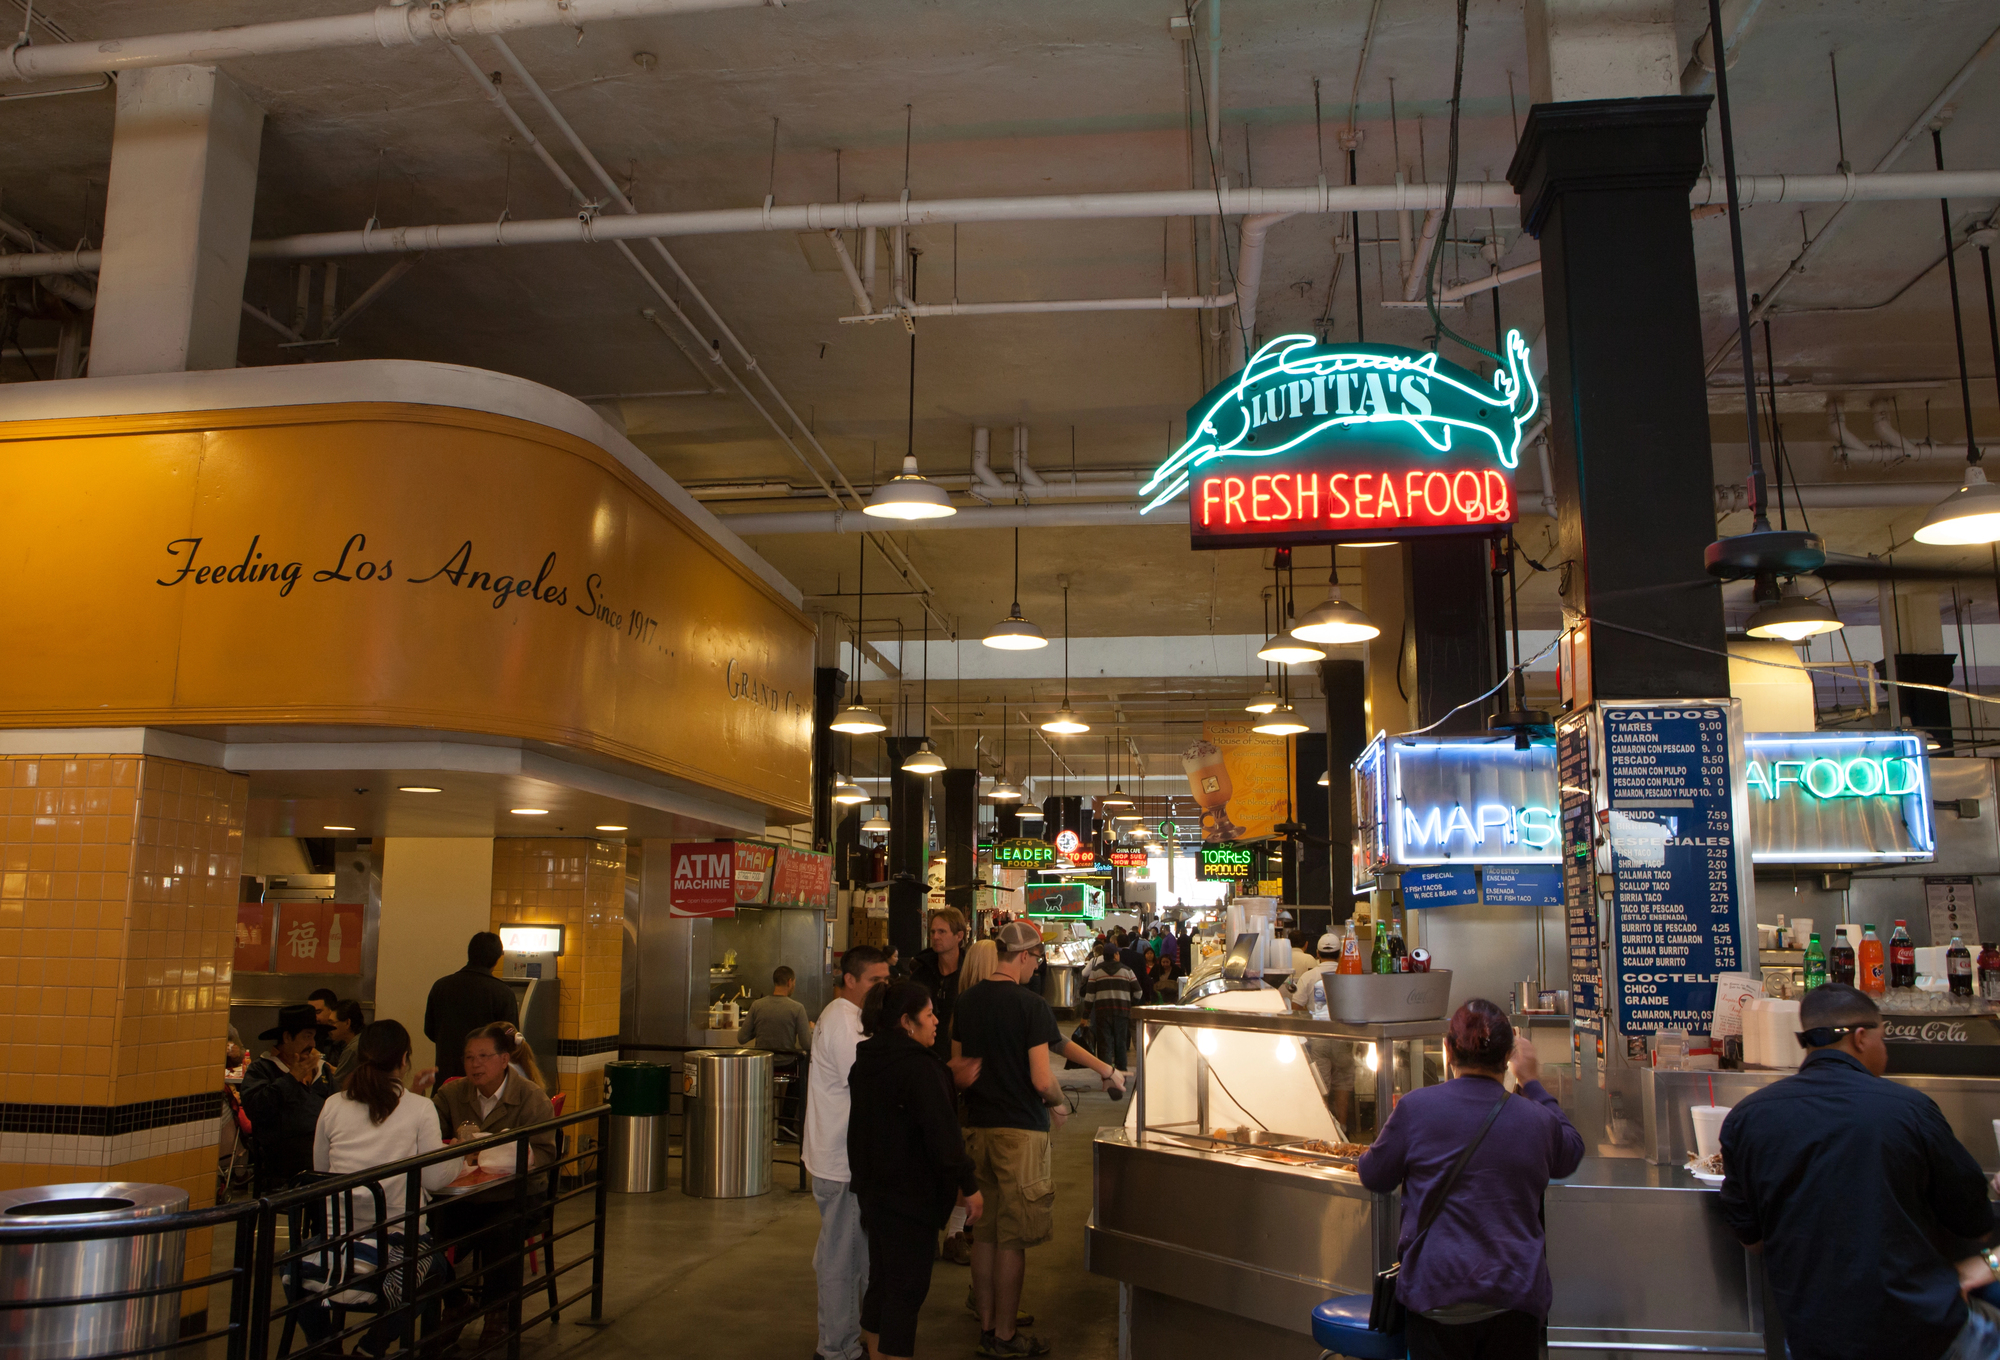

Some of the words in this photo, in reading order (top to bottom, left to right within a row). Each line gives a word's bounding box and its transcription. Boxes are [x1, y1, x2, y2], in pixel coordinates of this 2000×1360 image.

[1251, 373, 1432, 428] LUPITA'S
[1203, 473, 1318, 524] FRESH
[1329, 470, 1508, 519] SEAFOOD
[1466, 499, 1510, 522] D-3
[156, 534, 302, 597] Feeding
[313, 534, 393, 583] Los
[407, 541, 568, 609] Angeles
[575, 573, 622, 631] Since
[727, 658, 778, 713] GRAND
[1609, 710, 1720, 720] CALDOS
[1619, 723, 1652, 732] MARES
[1699, 722, 1722, 731] 9.00
[1213, 737, 1241, 745] House
[1242, 735, 1253, 745] of
[1611, 734, 1659, 742] CAMARON
[1612, 745, 1647, 754] CAMARON
[1648, 745, 1662, 753] CON
[1663, 744, 1695, 753] PESCADO
[1612, 756, 1656, 765] PESCADO
[1703, 755, 1724, 764] 8.50
[1613, 767, 1647, 775] CAMARON
[1648, 767, 1663, 775] CON
[1664, 766, 1687, 775] PULPO
[1701, 766, 1723, 775] 9.00
[1613, 778, 1646, 786] PESCADO
[1647, 778, 1662, 786] CON
[1662, 777, 1685, 786] PULPO
[1746, 757, 1922, 800] AFOOD
[1645, 789, 1672, 797] PESCADO
[1673, 789, 1678, 797] Y
[1679, 789, 1698, 797] PULPO
[1248, 798, 1276, 806] Blended
[1616, 811, 1655, 820] MENUDO
[1707, 811, 1727, 820] 7.59
[1404, 805, 1562, 846] MARIS
[1616, 822, 1648, 830] BIRRIA
[1707, 822, 1730, 831] 7.59
[1614, 837, 1730, 846] ESPECIALES
[995, 848, 1053, 860] LEADER
[1069, 853, 1080, 861] TO
[1081, 852, 1094, 860] GO
[1201, 850, 1251, 864] TORRES
[1618, 849, 1633, 857] FISH
[1634, 849, 1651, 857] TACO
[1707, 849, 1728, 857] 2.25
[738, 850, 766, 870] THAI
[1618, 860, 1643, 868] SHRIMP
[1644, 860, 1662, 868] TACO
[1707, 860, 1727, 869] 2.50
[674, 854, 730, 879] ATM
[1204, 864, 1248, 876] PRODUCE
[1422, 872, 1454, 881] ESPECIAL
[1619, 871, 1652, 879] CALAMAR
[1654, 871, 1672, 879] TACO
[1708, 871, 1727, 880] 2.75
[674, 879, 730, 890] MACHINE
[1136, 884, 1151, 892] G&B
[1619, 882, 1650, 891] SCALLOP
[1652, 882, 1670, 891] TACO
[1709, 882, 1728, 891] 2.75
[1028, 885, 1073, 904] MEXICAN
[1620, 893, 1642, 902] BIRRIA
[1644, 893, 1662, 902] TACO
[1710, 893, 1729, 902] 2.75
[1621, 904, 1638, 913] TACO
[1641, 904, 1650, 913] DE
[1652, 904, 1684, 913] PESCADO
[1710, 904, 1728, 914] 2.75
[1621, 924, 1651, 932] BURRITO
[1654, 924, 1663, 932] DE
[1665, 924, 1697, 932] PESCADO
[285, 921, 319, 959] 福
[1622, 935, 1653, 944] BURRITO
[1655, 935, 1664, 944] DE
[1667, 935, 1703, 944] CAMARON
[1714, 936, 1732, 944] 5.75
[1622, 946, 1655, 955] CALAMAR
[1659, 946, 1689, 955] BURRITO
[1714, 947, 1735, 956] 5.75
[1623, 958, 1654, 966] SCALLOP
[1656, 958, 1686, 966] BURRITO
[1715, 958, 1736, 967] 5.75
[1624, 985, 1657, 993] CHICO
[1625, 996, 1669, 1005] GRANDE
[1632, 1010, 1672, 1020] CAMARON,
[1673, 1010, 1700, 1020] PULPO,
[1668, 1022, 1693, 1031] CALLO
[1694, 1022, 1700, 1031] Y
